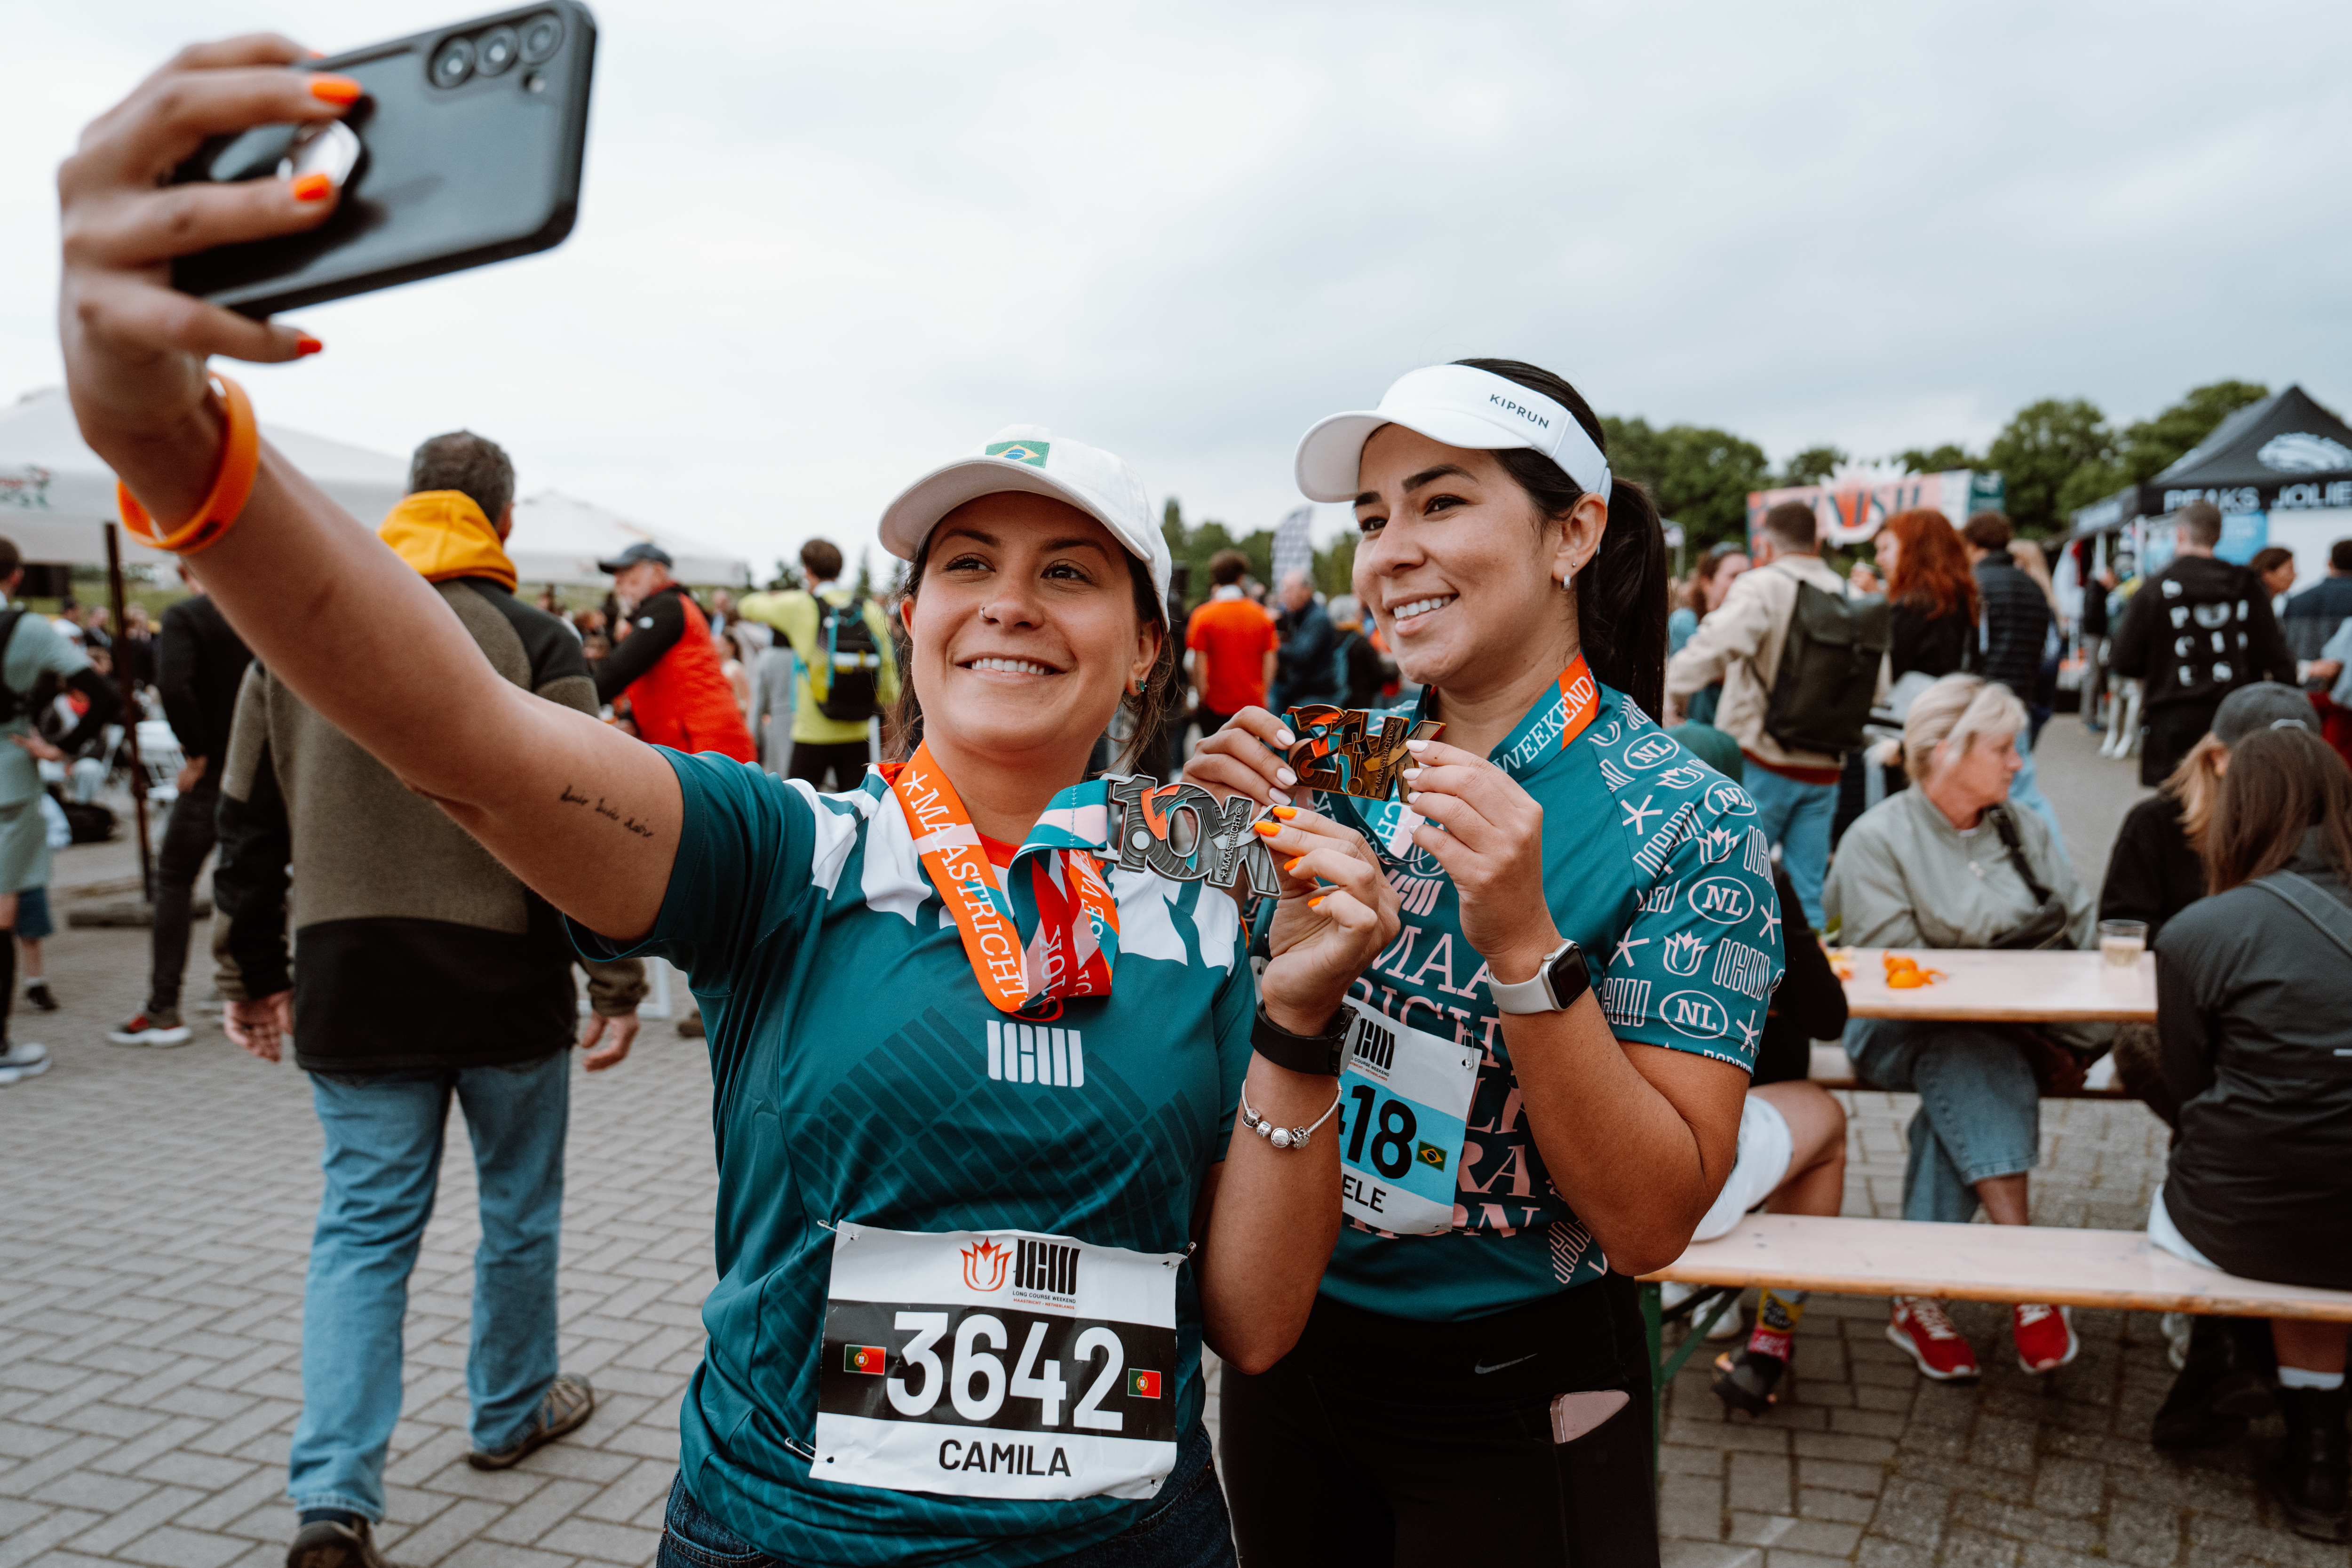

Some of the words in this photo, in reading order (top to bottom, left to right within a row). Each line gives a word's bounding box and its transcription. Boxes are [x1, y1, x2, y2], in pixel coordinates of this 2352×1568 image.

[1490, 394, 1549, 429] KIPRUN
[1492, 676, 1594, 773] WEEKEND
[1375, 732, 1393, 784] MAASTRICHT
[1631, 740, 1673, 764] NL
[1221, 815, 1241, 871] MAASTRICHT
[911, 788, 1028, 998] MAASTRICHT
[1701, 884, 1742, 916] NL
[1038, 924, 1066, 996] 10K
[1674, 998, 1717, 1031] NL
[1354, 1057, 1371, 1068] COURSE
[1371, 1065, 1390, 1077] WEEKEND
[1365, 1069, 1388, 1081] NETHERLANDS
[886, 1311, 1125, 1432] 3642
[939, 1439, 1072, 1478] CAMILA
